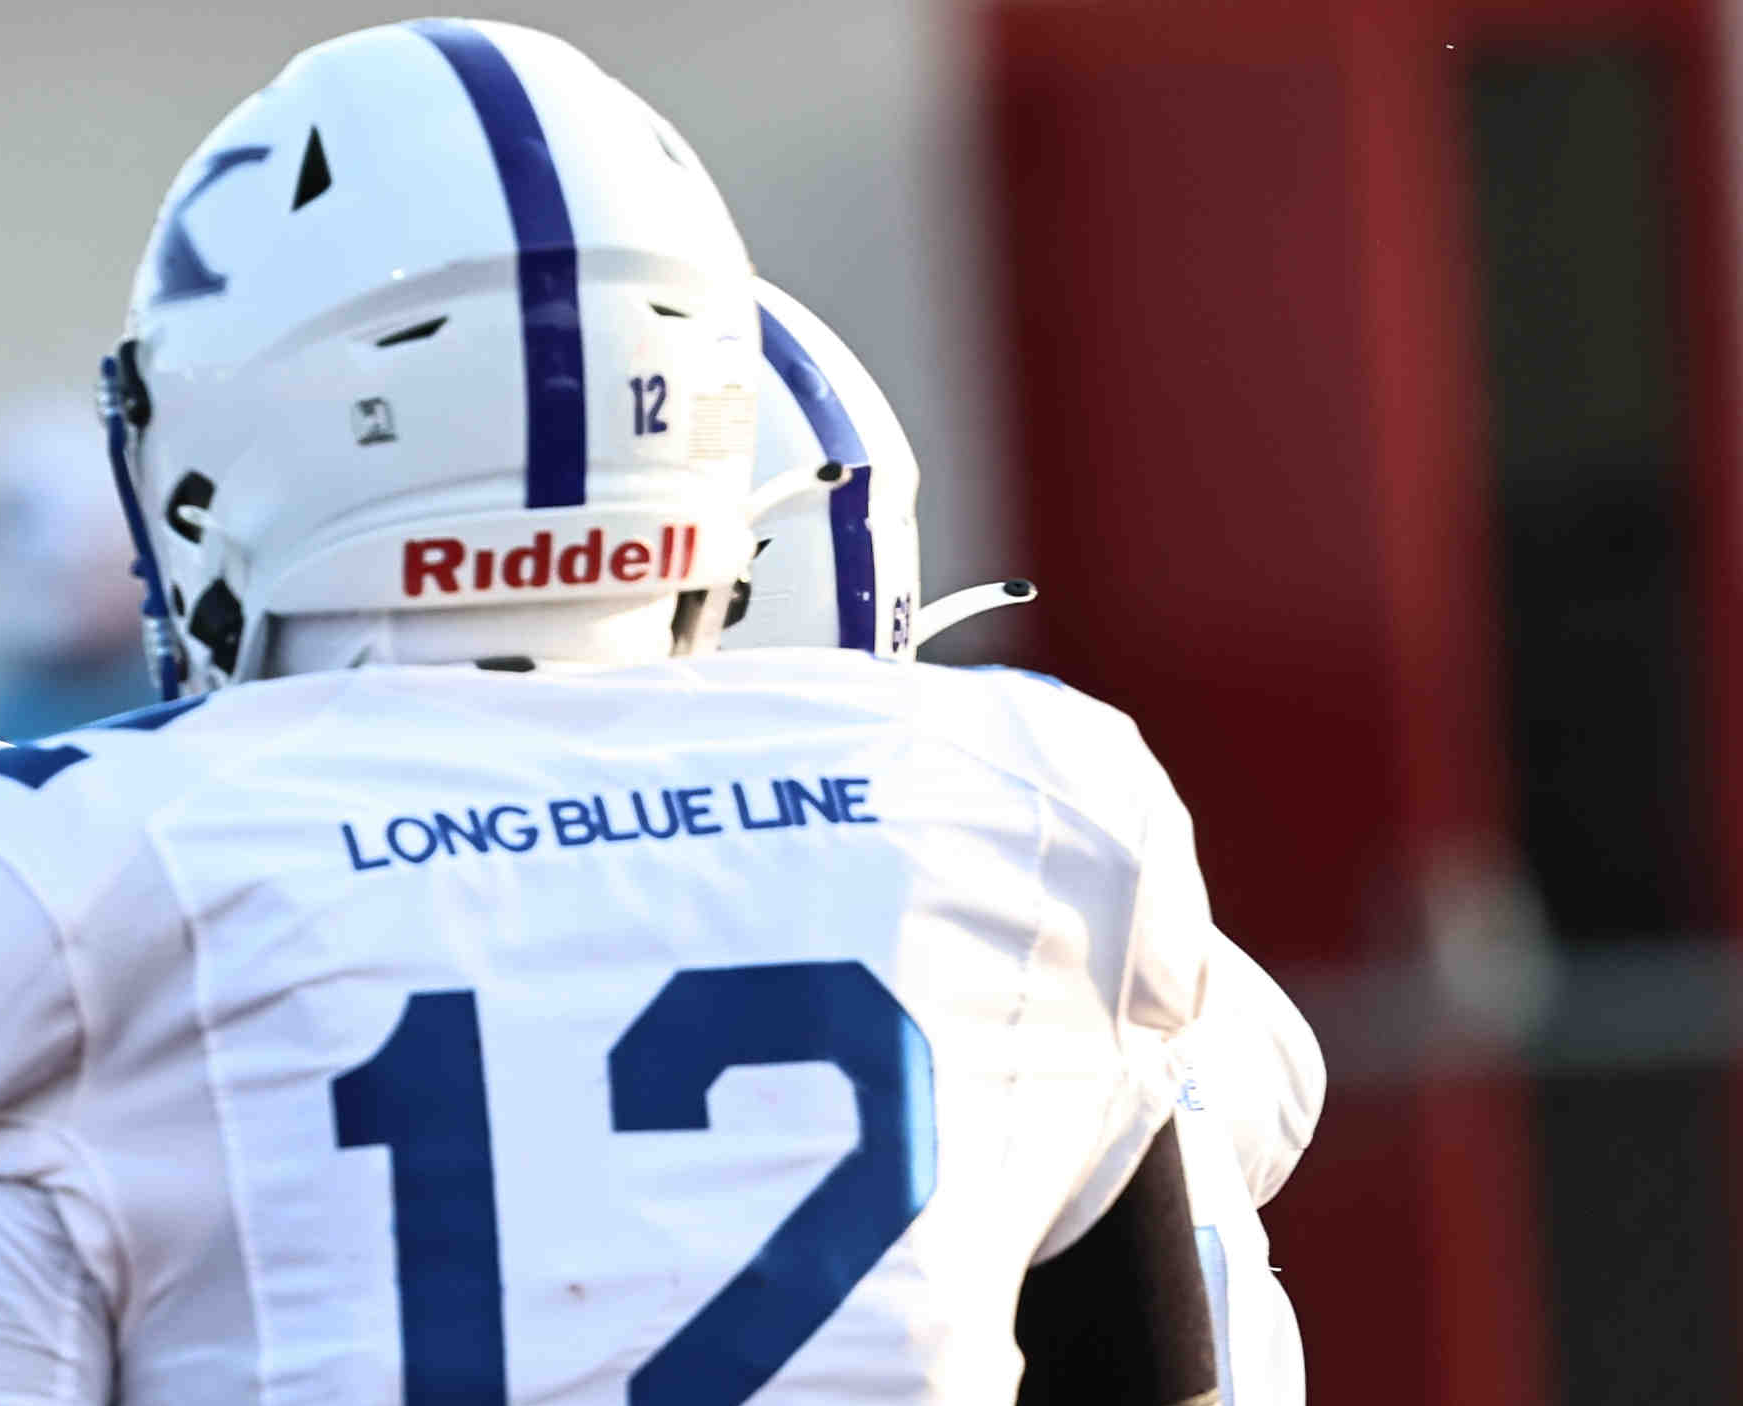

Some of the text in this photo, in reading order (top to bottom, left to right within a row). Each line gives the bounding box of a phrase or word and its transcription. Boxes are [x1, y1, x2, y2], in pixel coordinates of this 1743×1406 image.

[630, 373, 668, 436] 12
[403, 524, 697, 598] Riddell
[342, 778, 879, 871] LONG BLUE LINE
